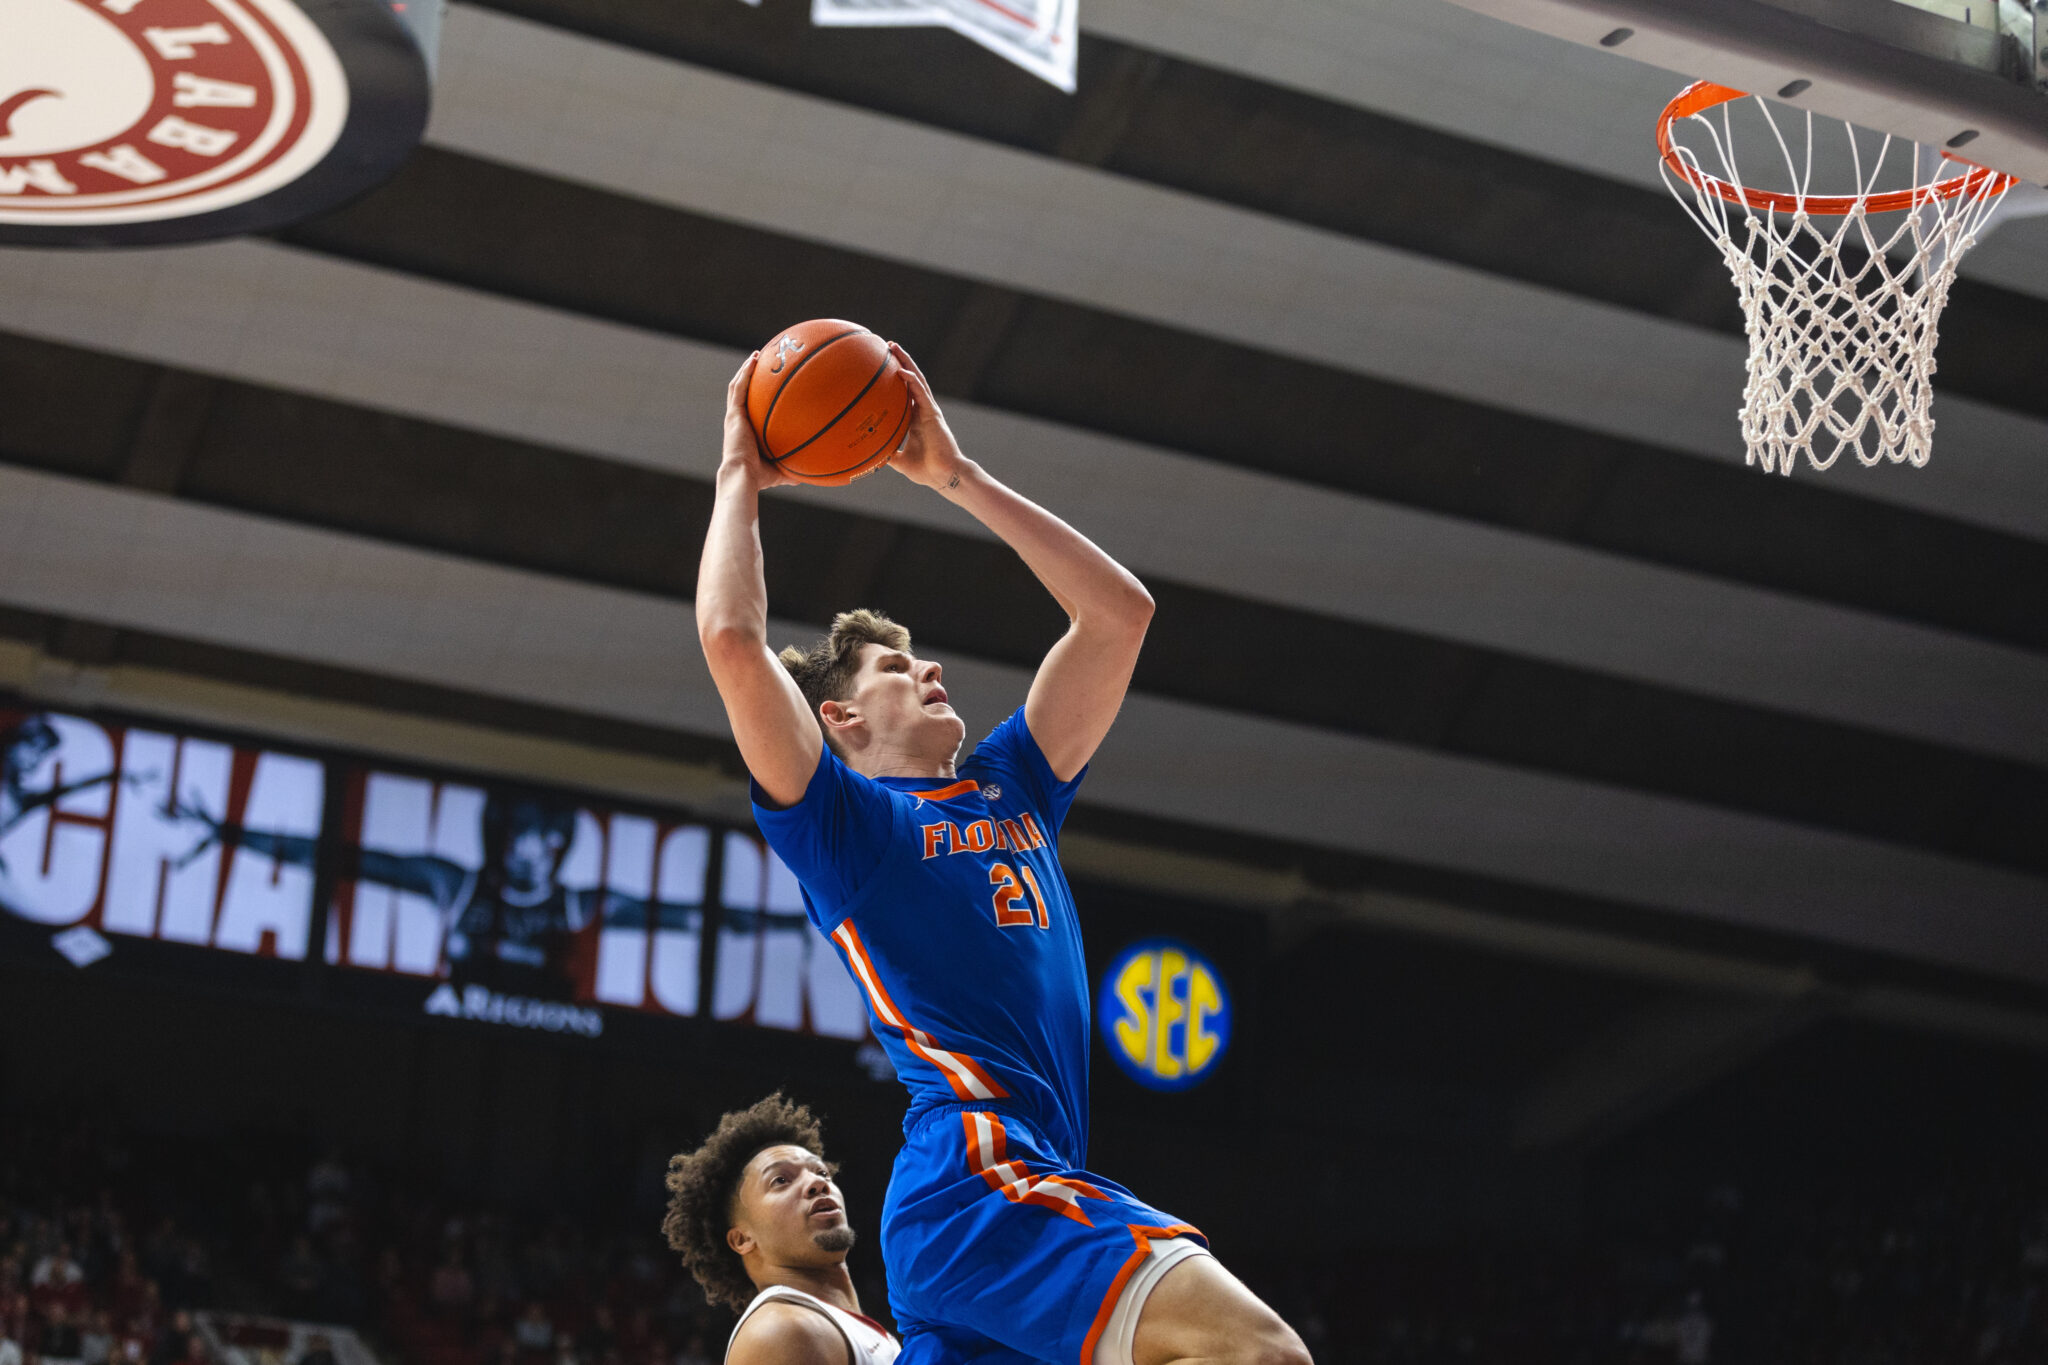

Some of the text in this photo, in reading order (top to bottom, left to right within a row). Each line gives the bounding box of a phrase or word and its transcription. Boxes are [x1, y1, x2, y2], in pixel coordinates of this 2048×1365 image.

[920, 812, 1048, 860] FLODA
[989, 863, 1050, 929] 21
[1114, 949, 1223, 1079] SEC
